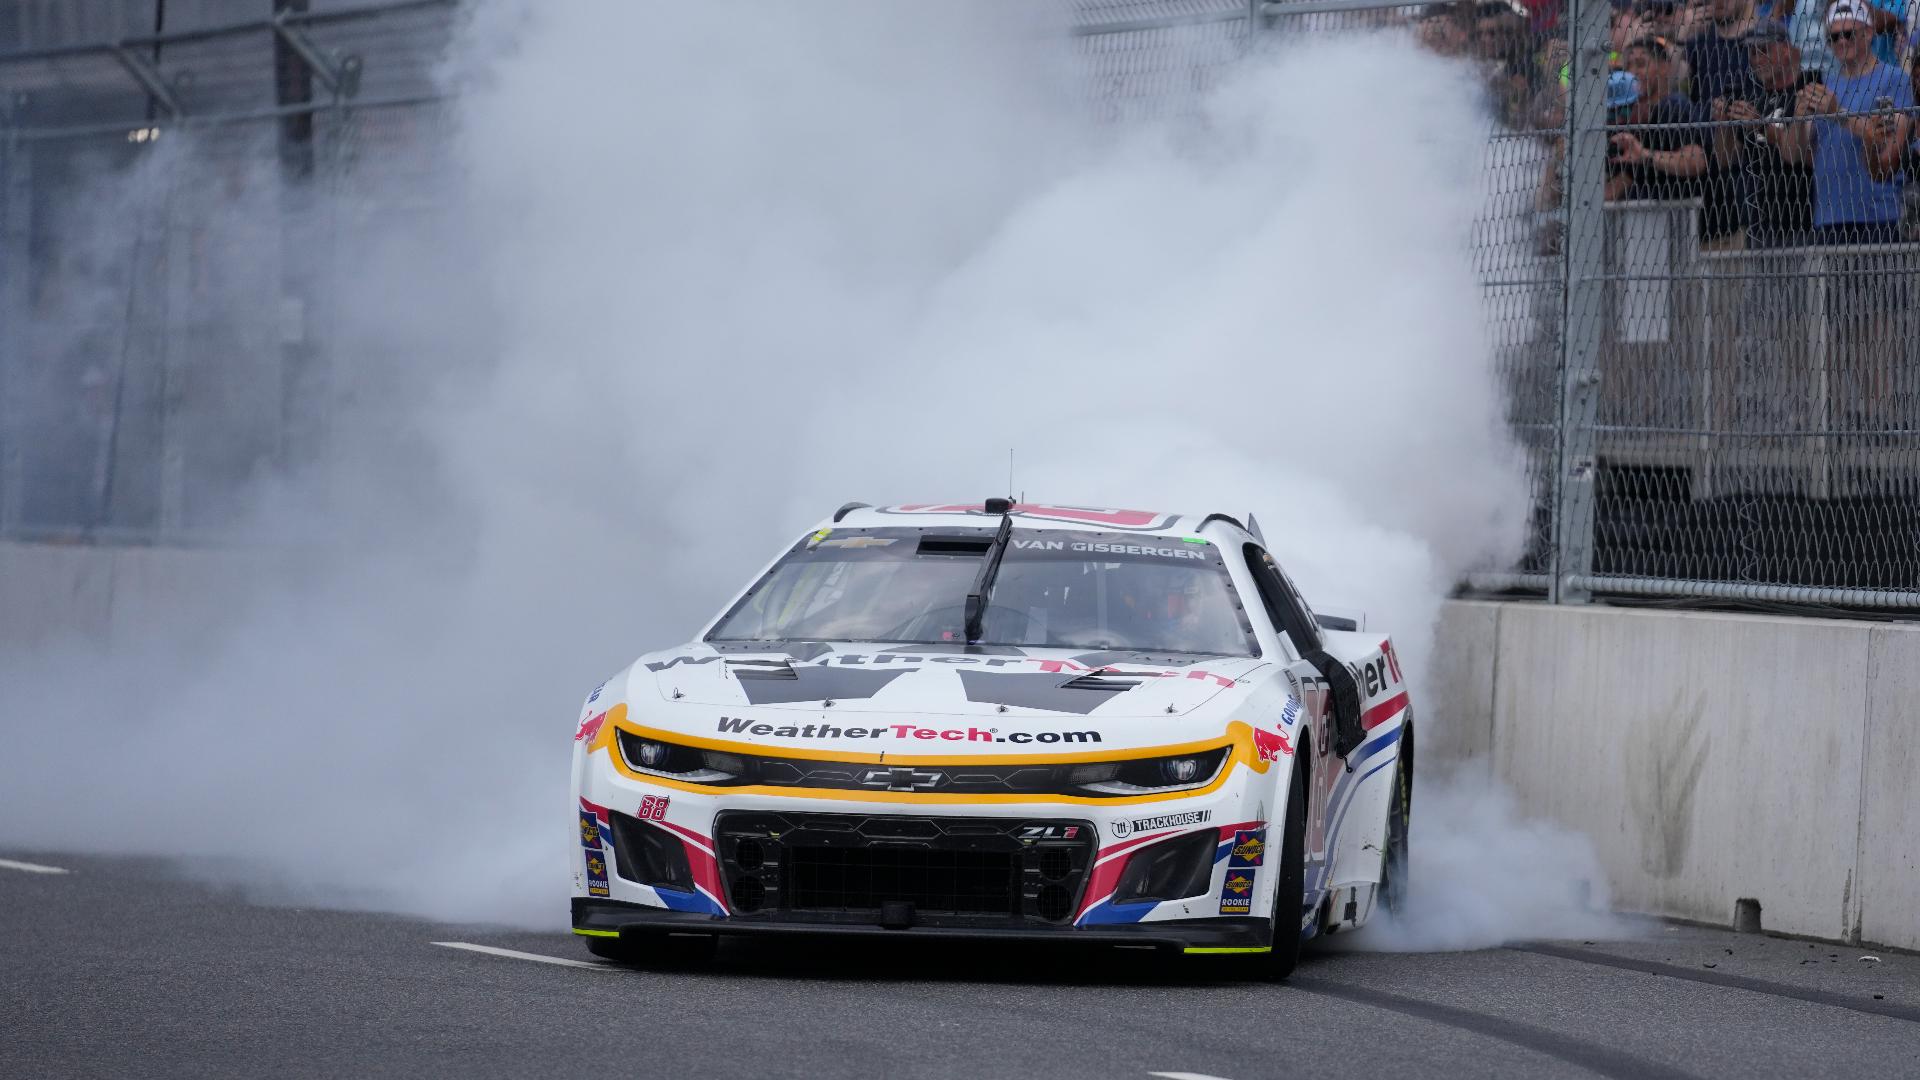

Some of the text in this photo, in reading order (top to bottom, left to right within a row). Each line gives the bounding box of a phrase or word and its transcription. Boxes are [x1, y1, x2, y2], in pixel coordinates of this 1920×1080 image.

[1012, 539, 1206, 561] VAN GISBERGEN
[636, 794, 670, 822] 88
[1137, 812, 1200, 831] TRACKHOUSE
[1017, 826, 1079, 839] ZL1
[1221, 898, 1250, 906] ROOKIE
